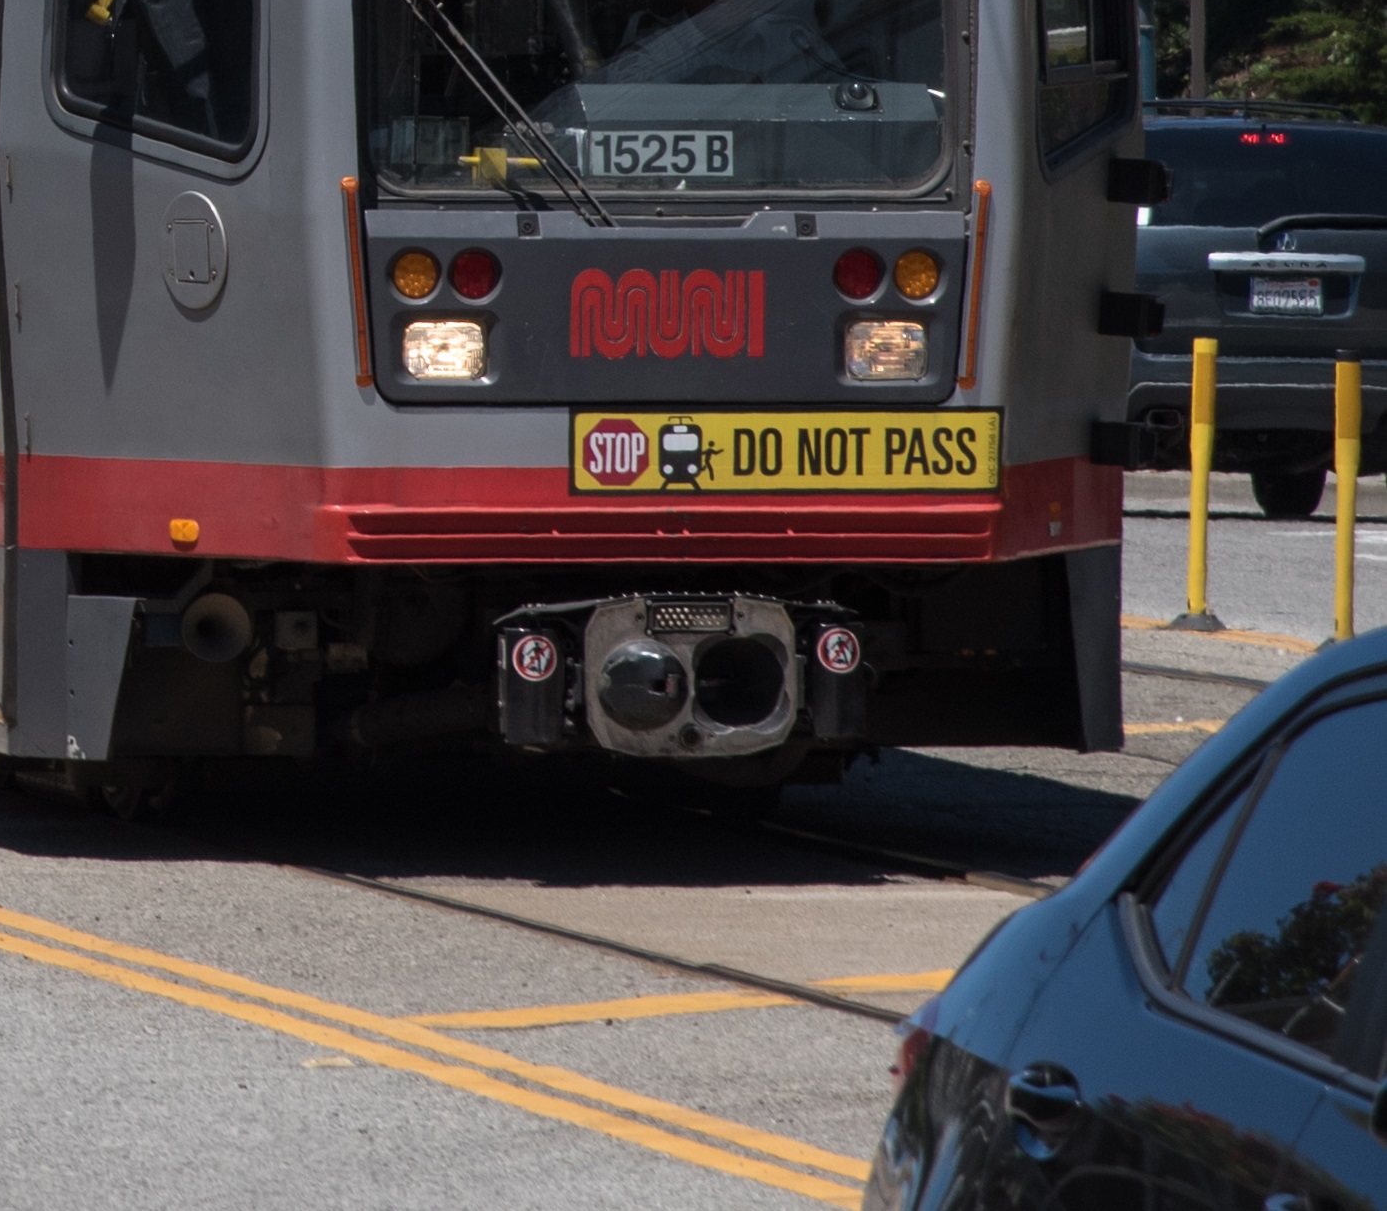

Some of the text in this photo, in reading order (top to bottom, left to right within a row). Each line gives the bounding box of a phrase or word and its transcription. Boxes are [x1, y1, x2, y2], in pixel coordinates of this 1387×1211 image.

[593, 134, 730, 175] 1525 B
[588, 431, 646, 474] STOP
[732, 426, 978, 477] DO NOT PASS
